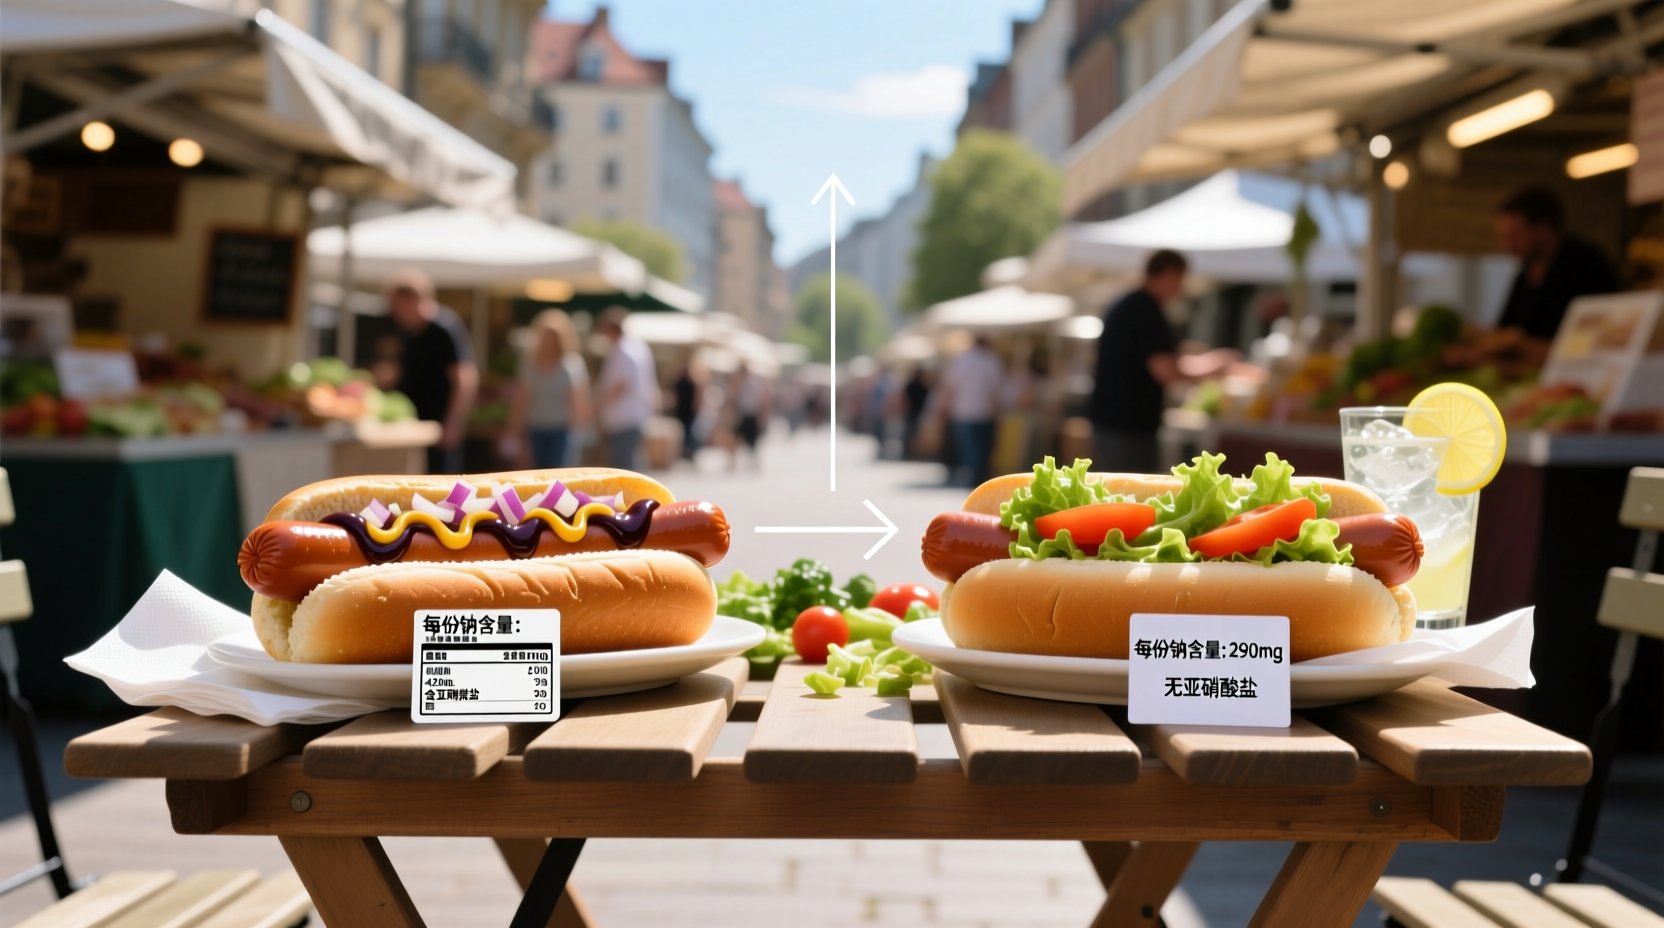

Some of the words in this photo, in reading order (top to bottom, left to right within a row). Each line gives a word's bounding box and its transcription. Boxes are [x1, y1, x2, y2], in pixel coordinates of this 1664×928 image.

[1134, 638, 1283, 663] 每份钠含量:290mg
[1164, 676, 1258, 699] 无亚硝酸盐
